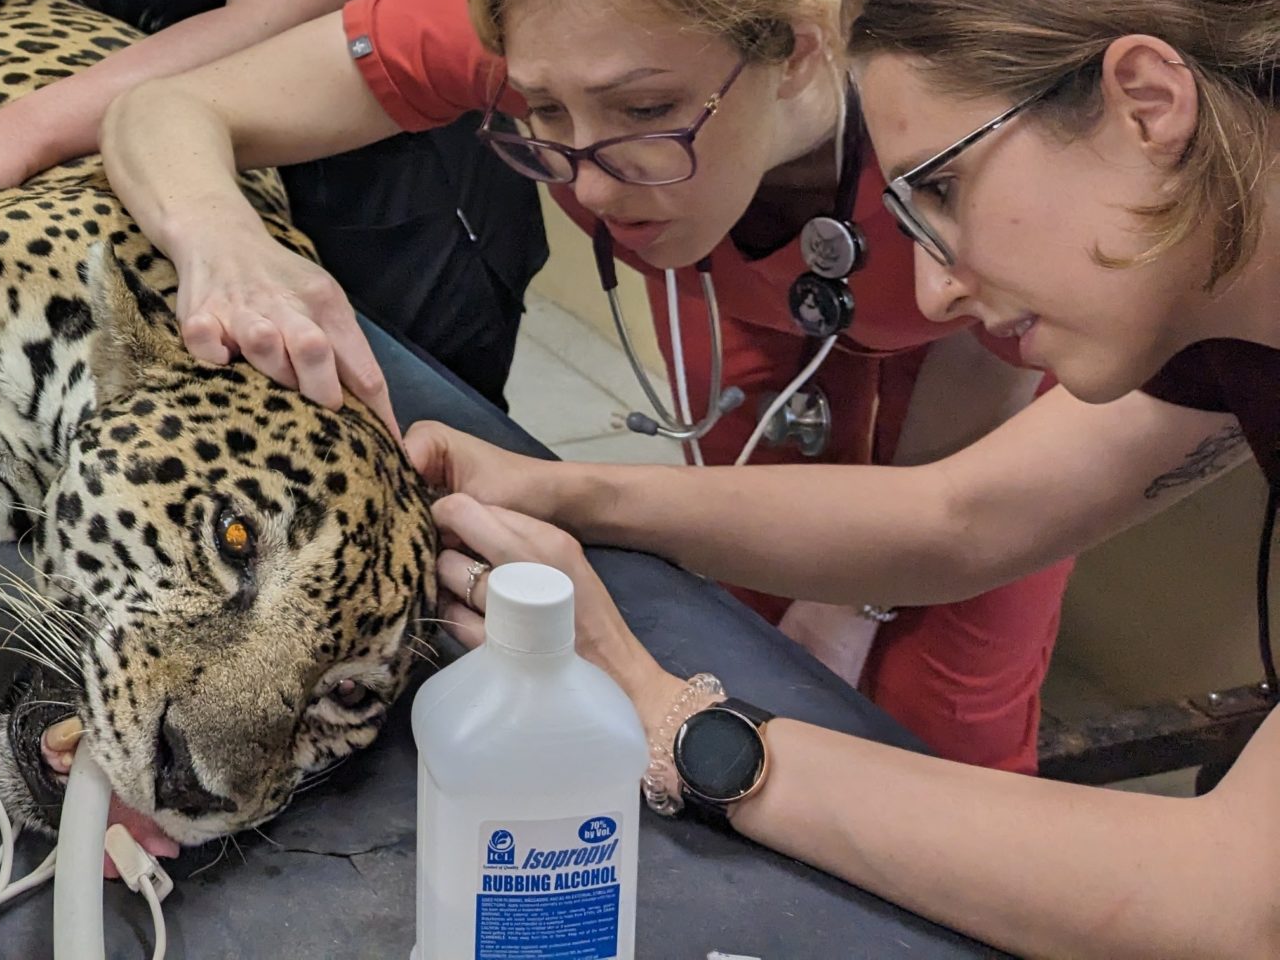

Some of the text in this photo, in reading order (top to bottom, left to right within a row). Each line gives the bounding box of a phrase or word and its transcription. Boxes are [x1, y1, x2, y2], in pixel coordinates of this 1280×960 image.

[590, 820, 607, 831] 70%
[584, 830, 595, 840] by
[489, 852, 513, 861] ICL
[521, 838, 619, 870] Isopropyl
[482, 866, 617, 892] RUBBING ALCOHOL
